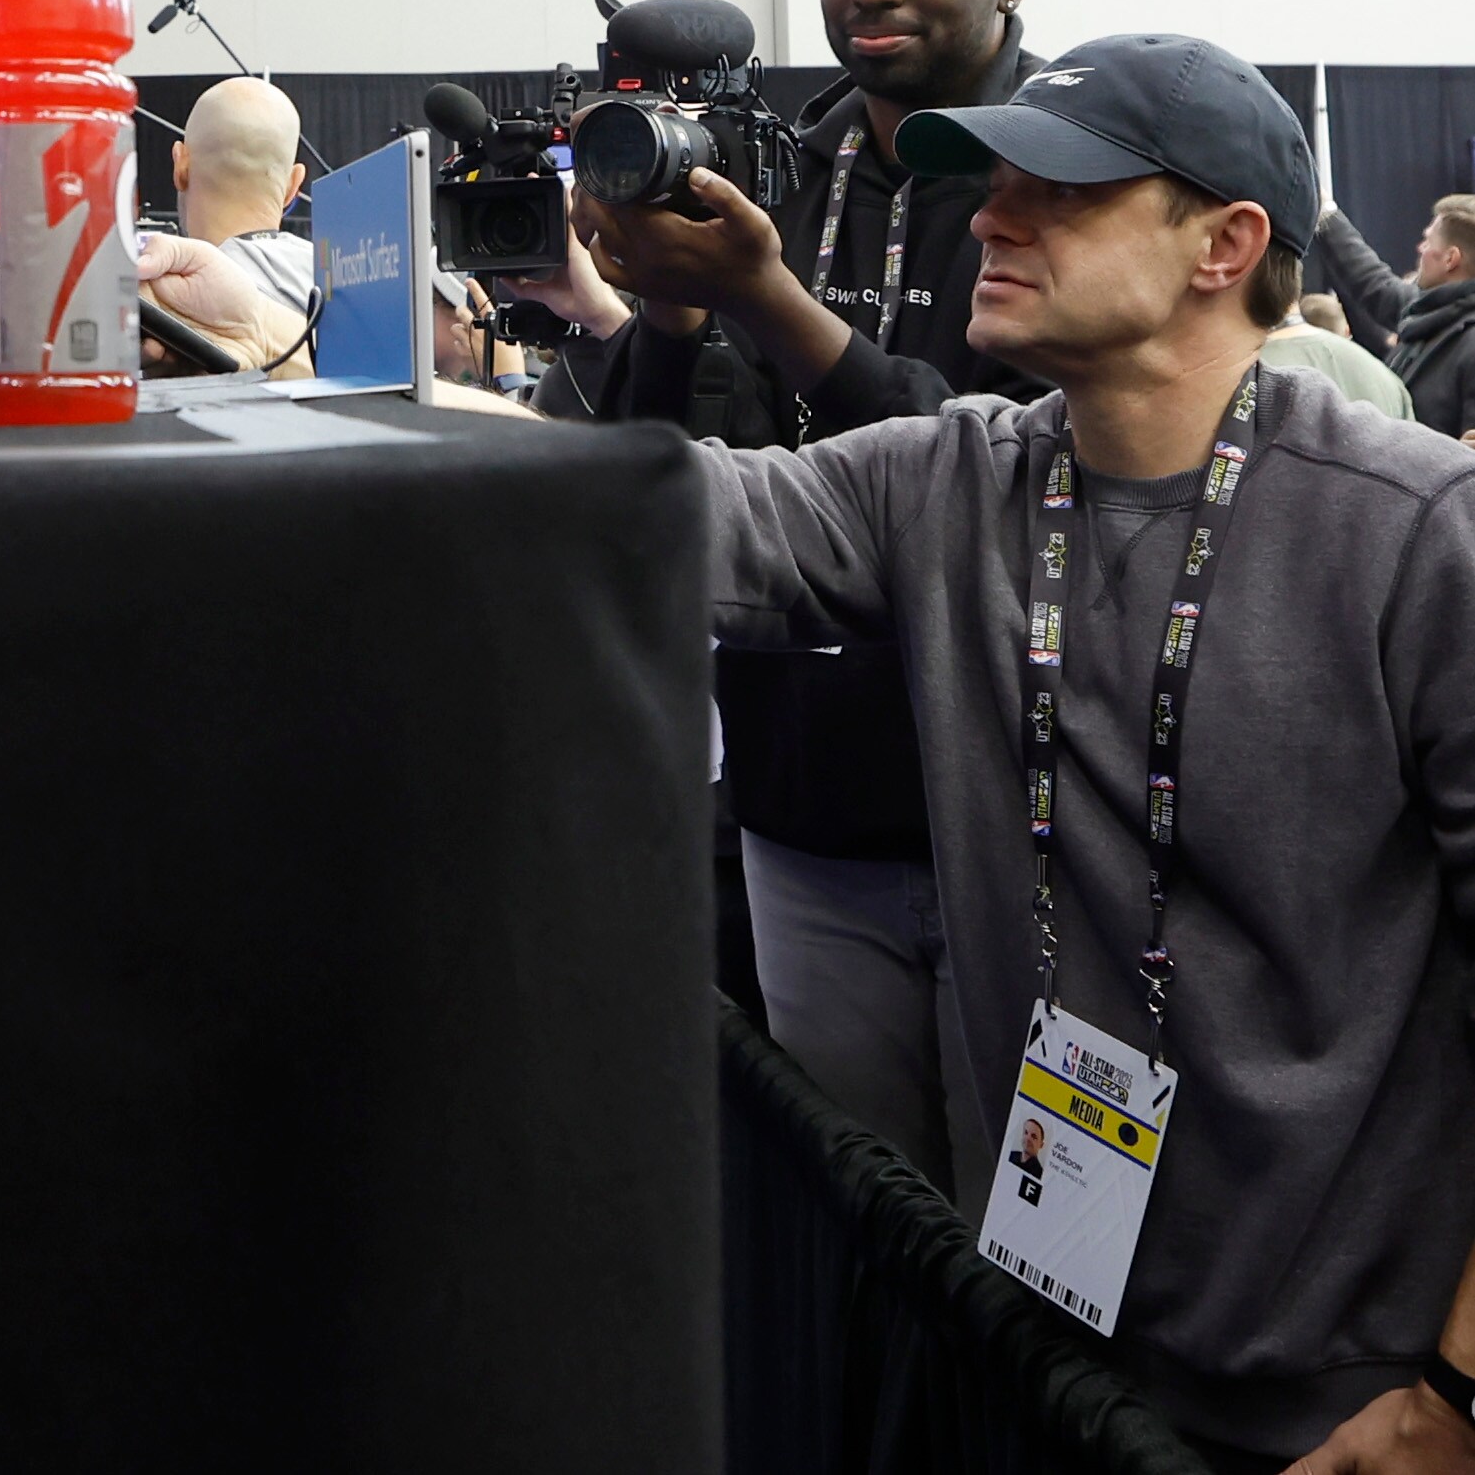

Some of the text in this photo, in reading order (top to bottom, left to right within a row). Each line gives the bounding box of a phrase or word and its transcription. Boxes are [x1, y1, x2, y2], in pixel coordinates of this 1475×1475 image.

[1047, 75, 1084, 86] GOLF
[367, 231, 400, 283] Surface
[1212, 457, 1228, 480] UTAH
[1030, 618, 1046, 649] ALL-STAR
[1045, 627, 1058, 649] UTAH
[1169, 617, 1182, 641] UTAH
[1179, 617, 1196, 650] ALL-STAR
[1036, 692, 1050, 742] UT 23
[1080, 1050, 1133, 1089] ALL-STAR 2023
[1068, 1095, 1104, 1131] MEDIA
[1053, 1142, 1068, 1154] JOE
[1051, 1149, 1083, 1173] VARDON
[1025, 1182, 1036, 1196] F
